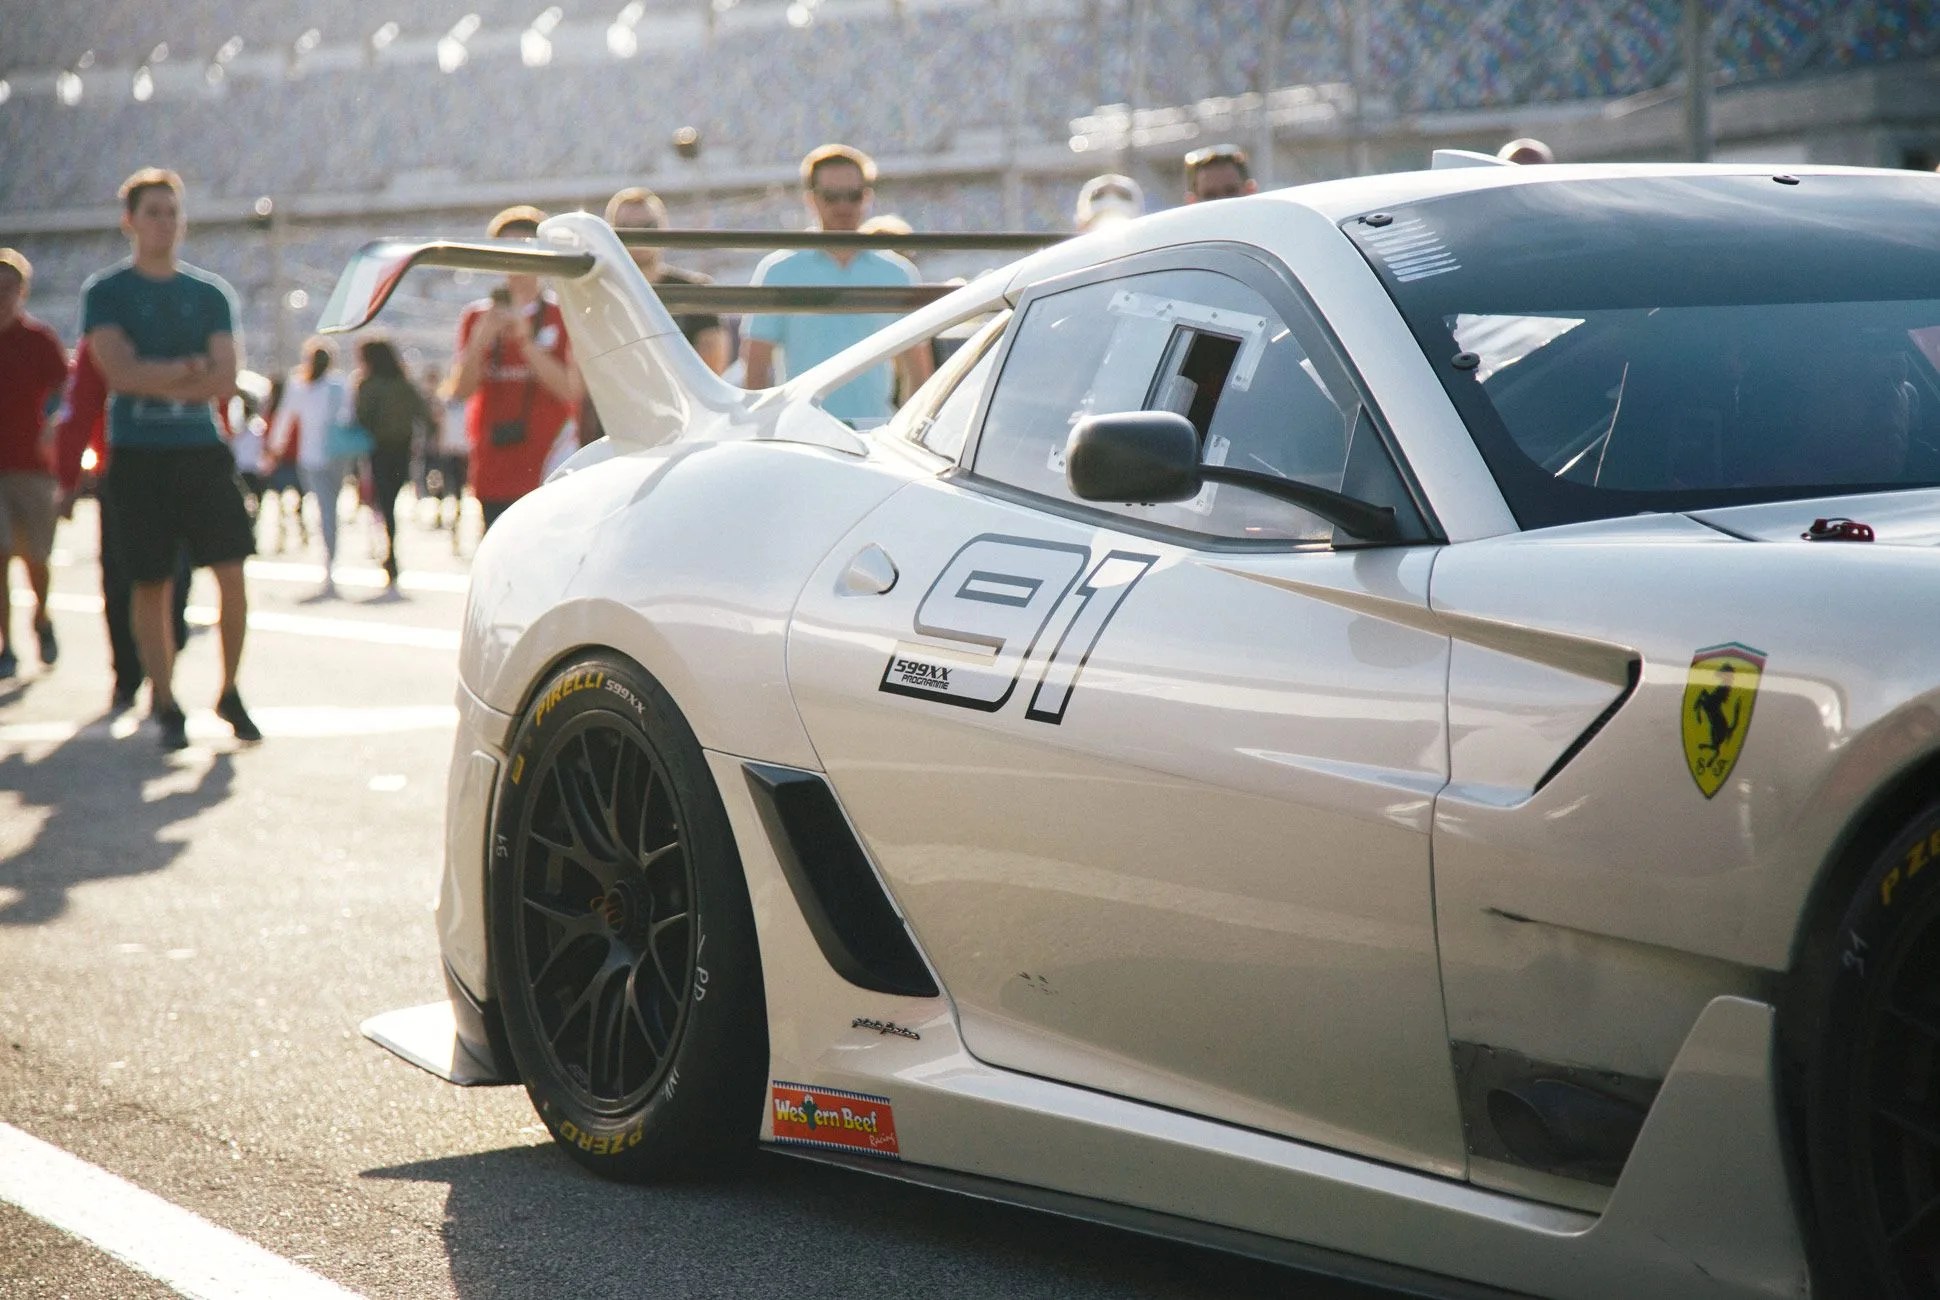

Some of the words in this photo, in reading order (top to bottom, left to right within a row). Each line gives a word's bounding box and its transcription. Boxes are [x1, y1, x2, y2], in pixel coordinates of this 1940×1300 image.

[879, 532, 1161, 725] 91
[894, 659, 953, 681] 599XX
[901, 674, 950, 690] PROGRAMME
[535, 672, 604, 727] PIRELLI
[605, 678, 646, 714] 599XX
[774, 1094, 840, 1131] Western
[841, 1107, 878, 1133] Beef
[559, 1119, 625, 1156] ZERO
